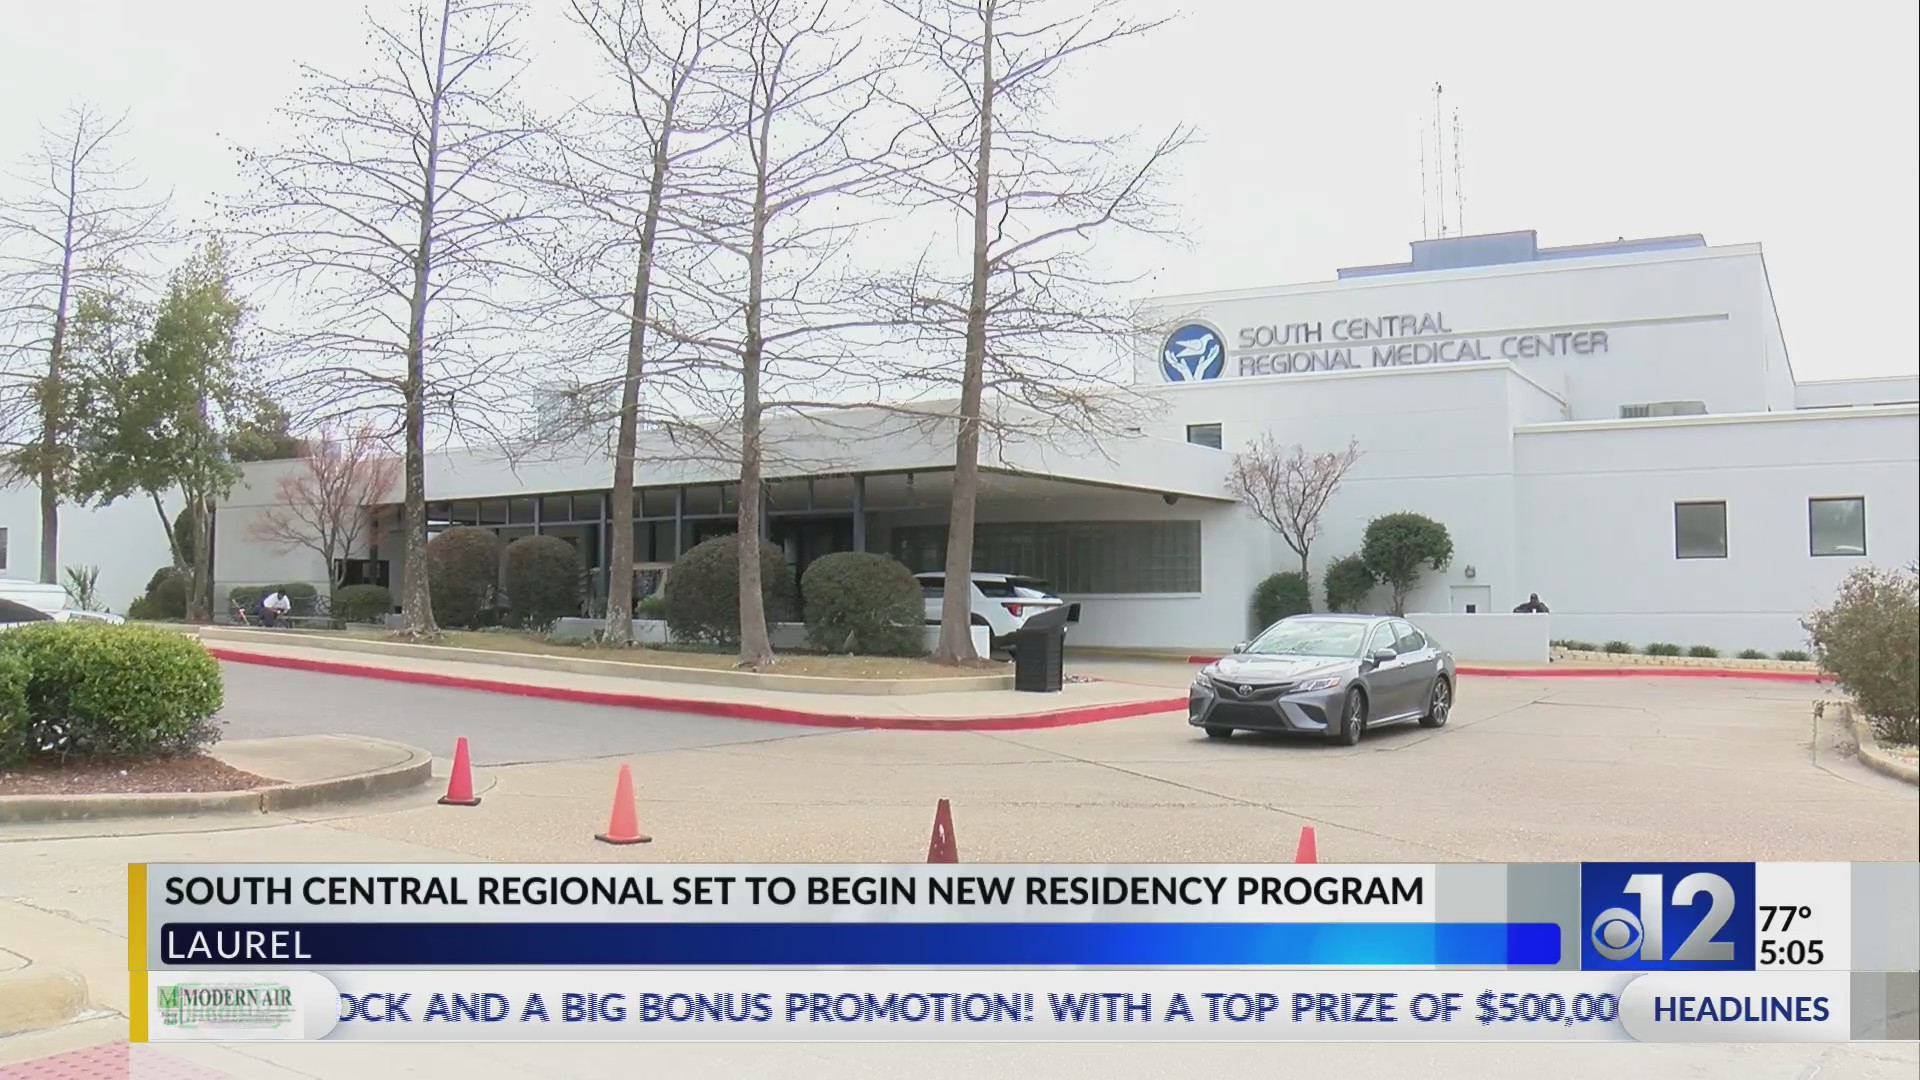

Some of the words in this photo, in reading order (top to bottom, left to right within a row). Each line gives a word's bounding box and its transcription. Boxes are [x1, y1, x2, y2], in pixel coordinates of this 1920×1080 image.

[1239, 321, 1322, 349] SOUTH
[1331, 311, 1452, 341] CENTRAL
[1239, 349, 1361, 377] REGIONAL
[1372, 338, 1490, 367] MEDICAL
[1500, 329, 1608, 358] CENTER
